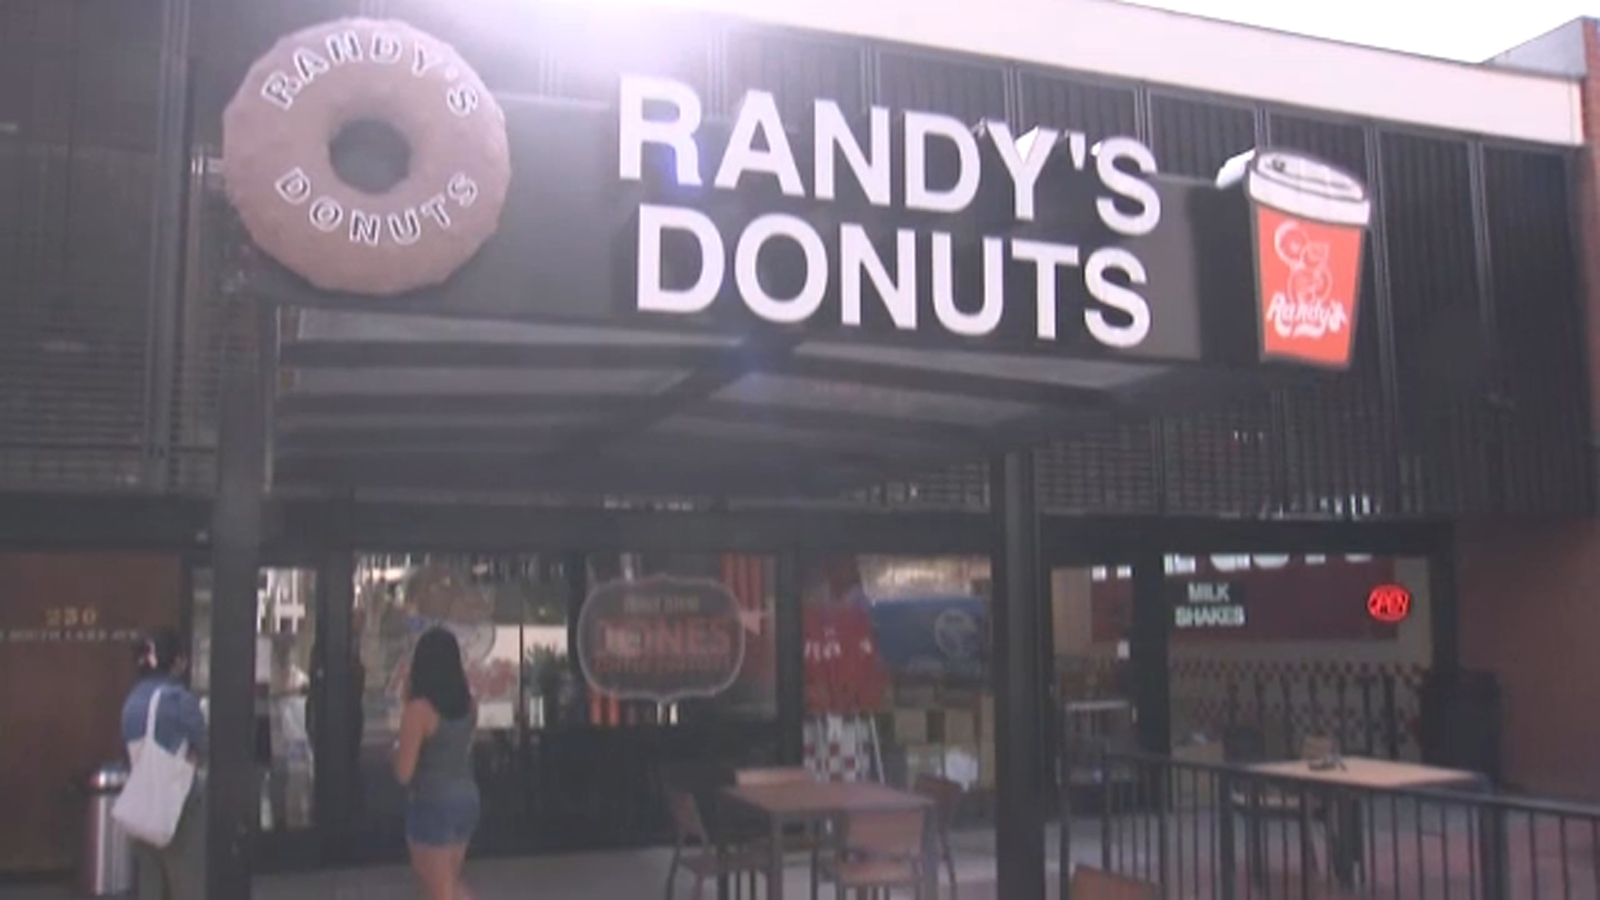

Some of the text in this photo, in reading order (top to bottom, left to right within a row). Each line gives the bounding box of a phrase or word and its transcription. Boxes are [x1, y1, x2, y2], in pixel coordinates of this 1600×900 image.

[262, 31, 479, 118] RANDY'S
[618, 74, 1162, 236] RANDY'S
[275, 166, 479, 246] DONUTS
[637, 203, 1151, 348] DONUTS
[1266, 290, 1346, 338] Randy's
[1174, 605, 1245, 627] SHAKES
[1187, 582, 1230, 602] MILK
[1368, 588, 1408, 618] OPEN
